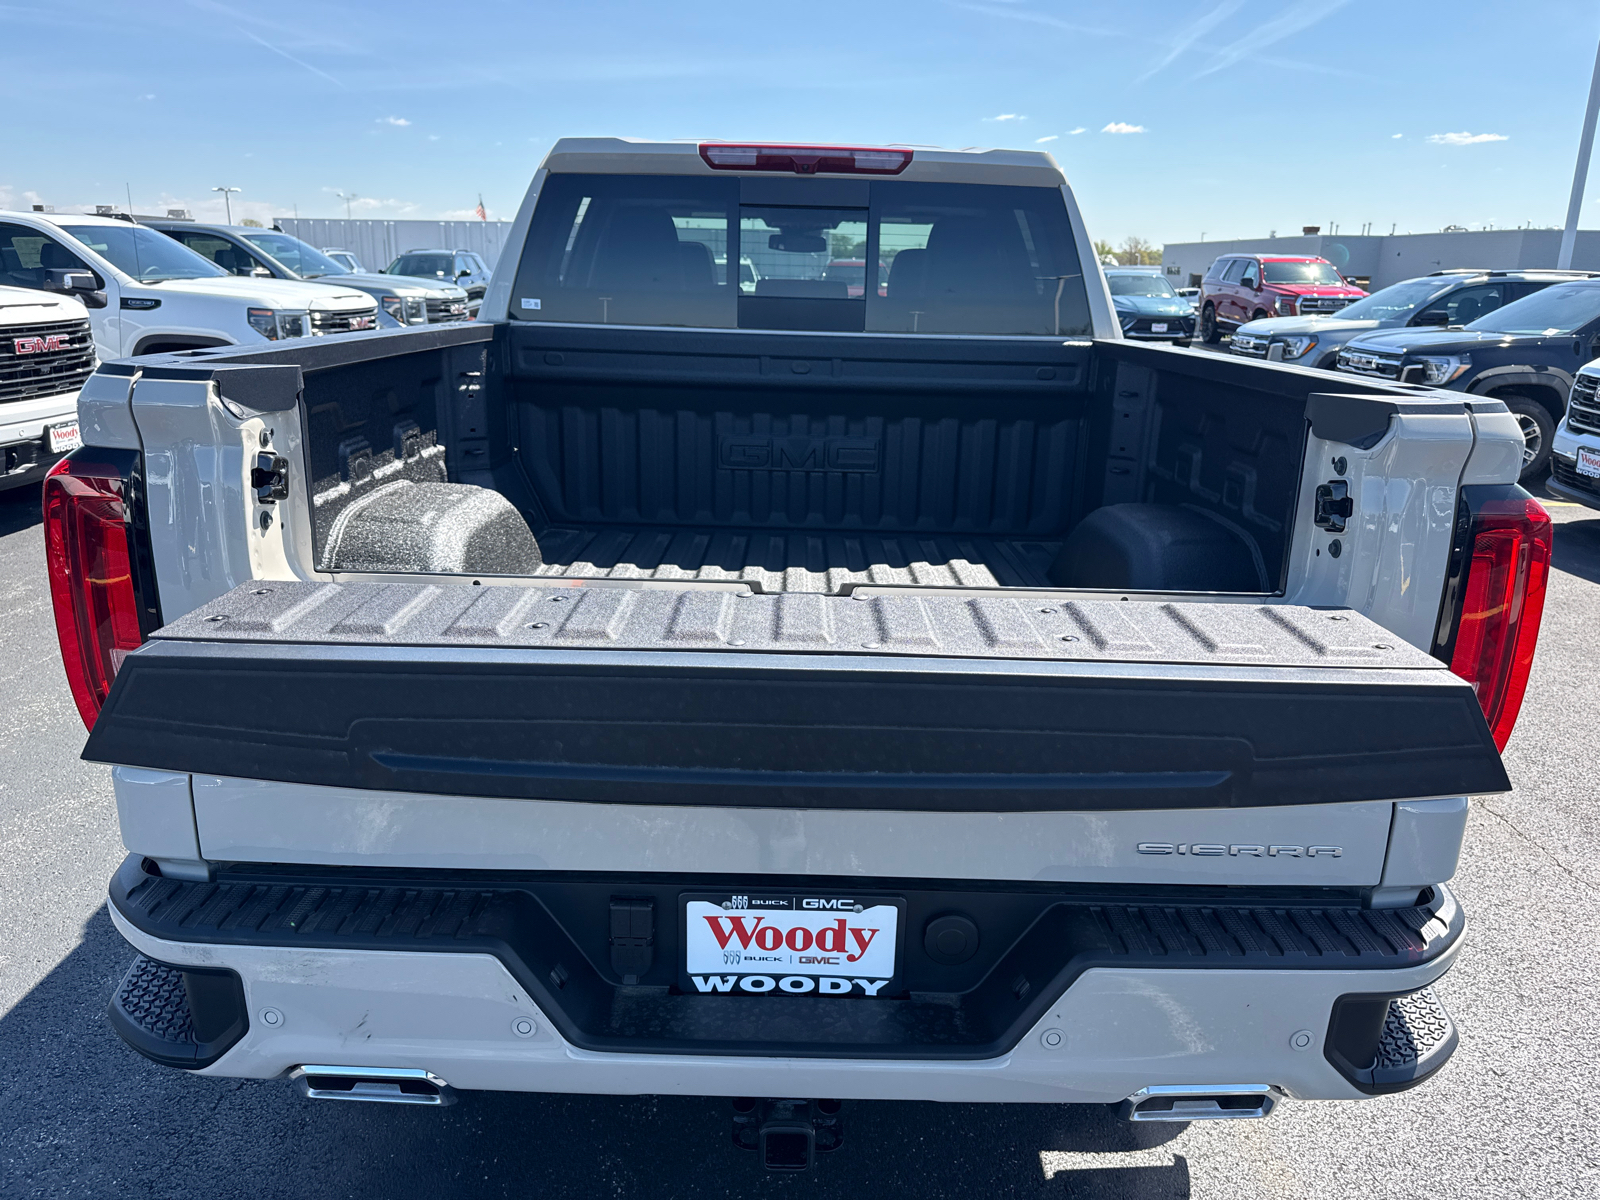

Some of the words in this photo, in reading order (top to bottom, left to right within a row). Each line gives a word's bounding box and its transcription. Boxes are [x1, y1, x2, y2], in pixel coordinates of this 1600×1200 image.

[13, 334, 70, 355] GMC
[52, 427, 79, 440] Woody
[719, 436, 880, 473] GMC
[1137, 842, 1343, 858] SIERRA
[802, 898, 854, 910] GMC
[702, 915, 880, 963] Woody
[798, 955, 840, 965] GMC
[691, 975, 890, 996] WOODY
